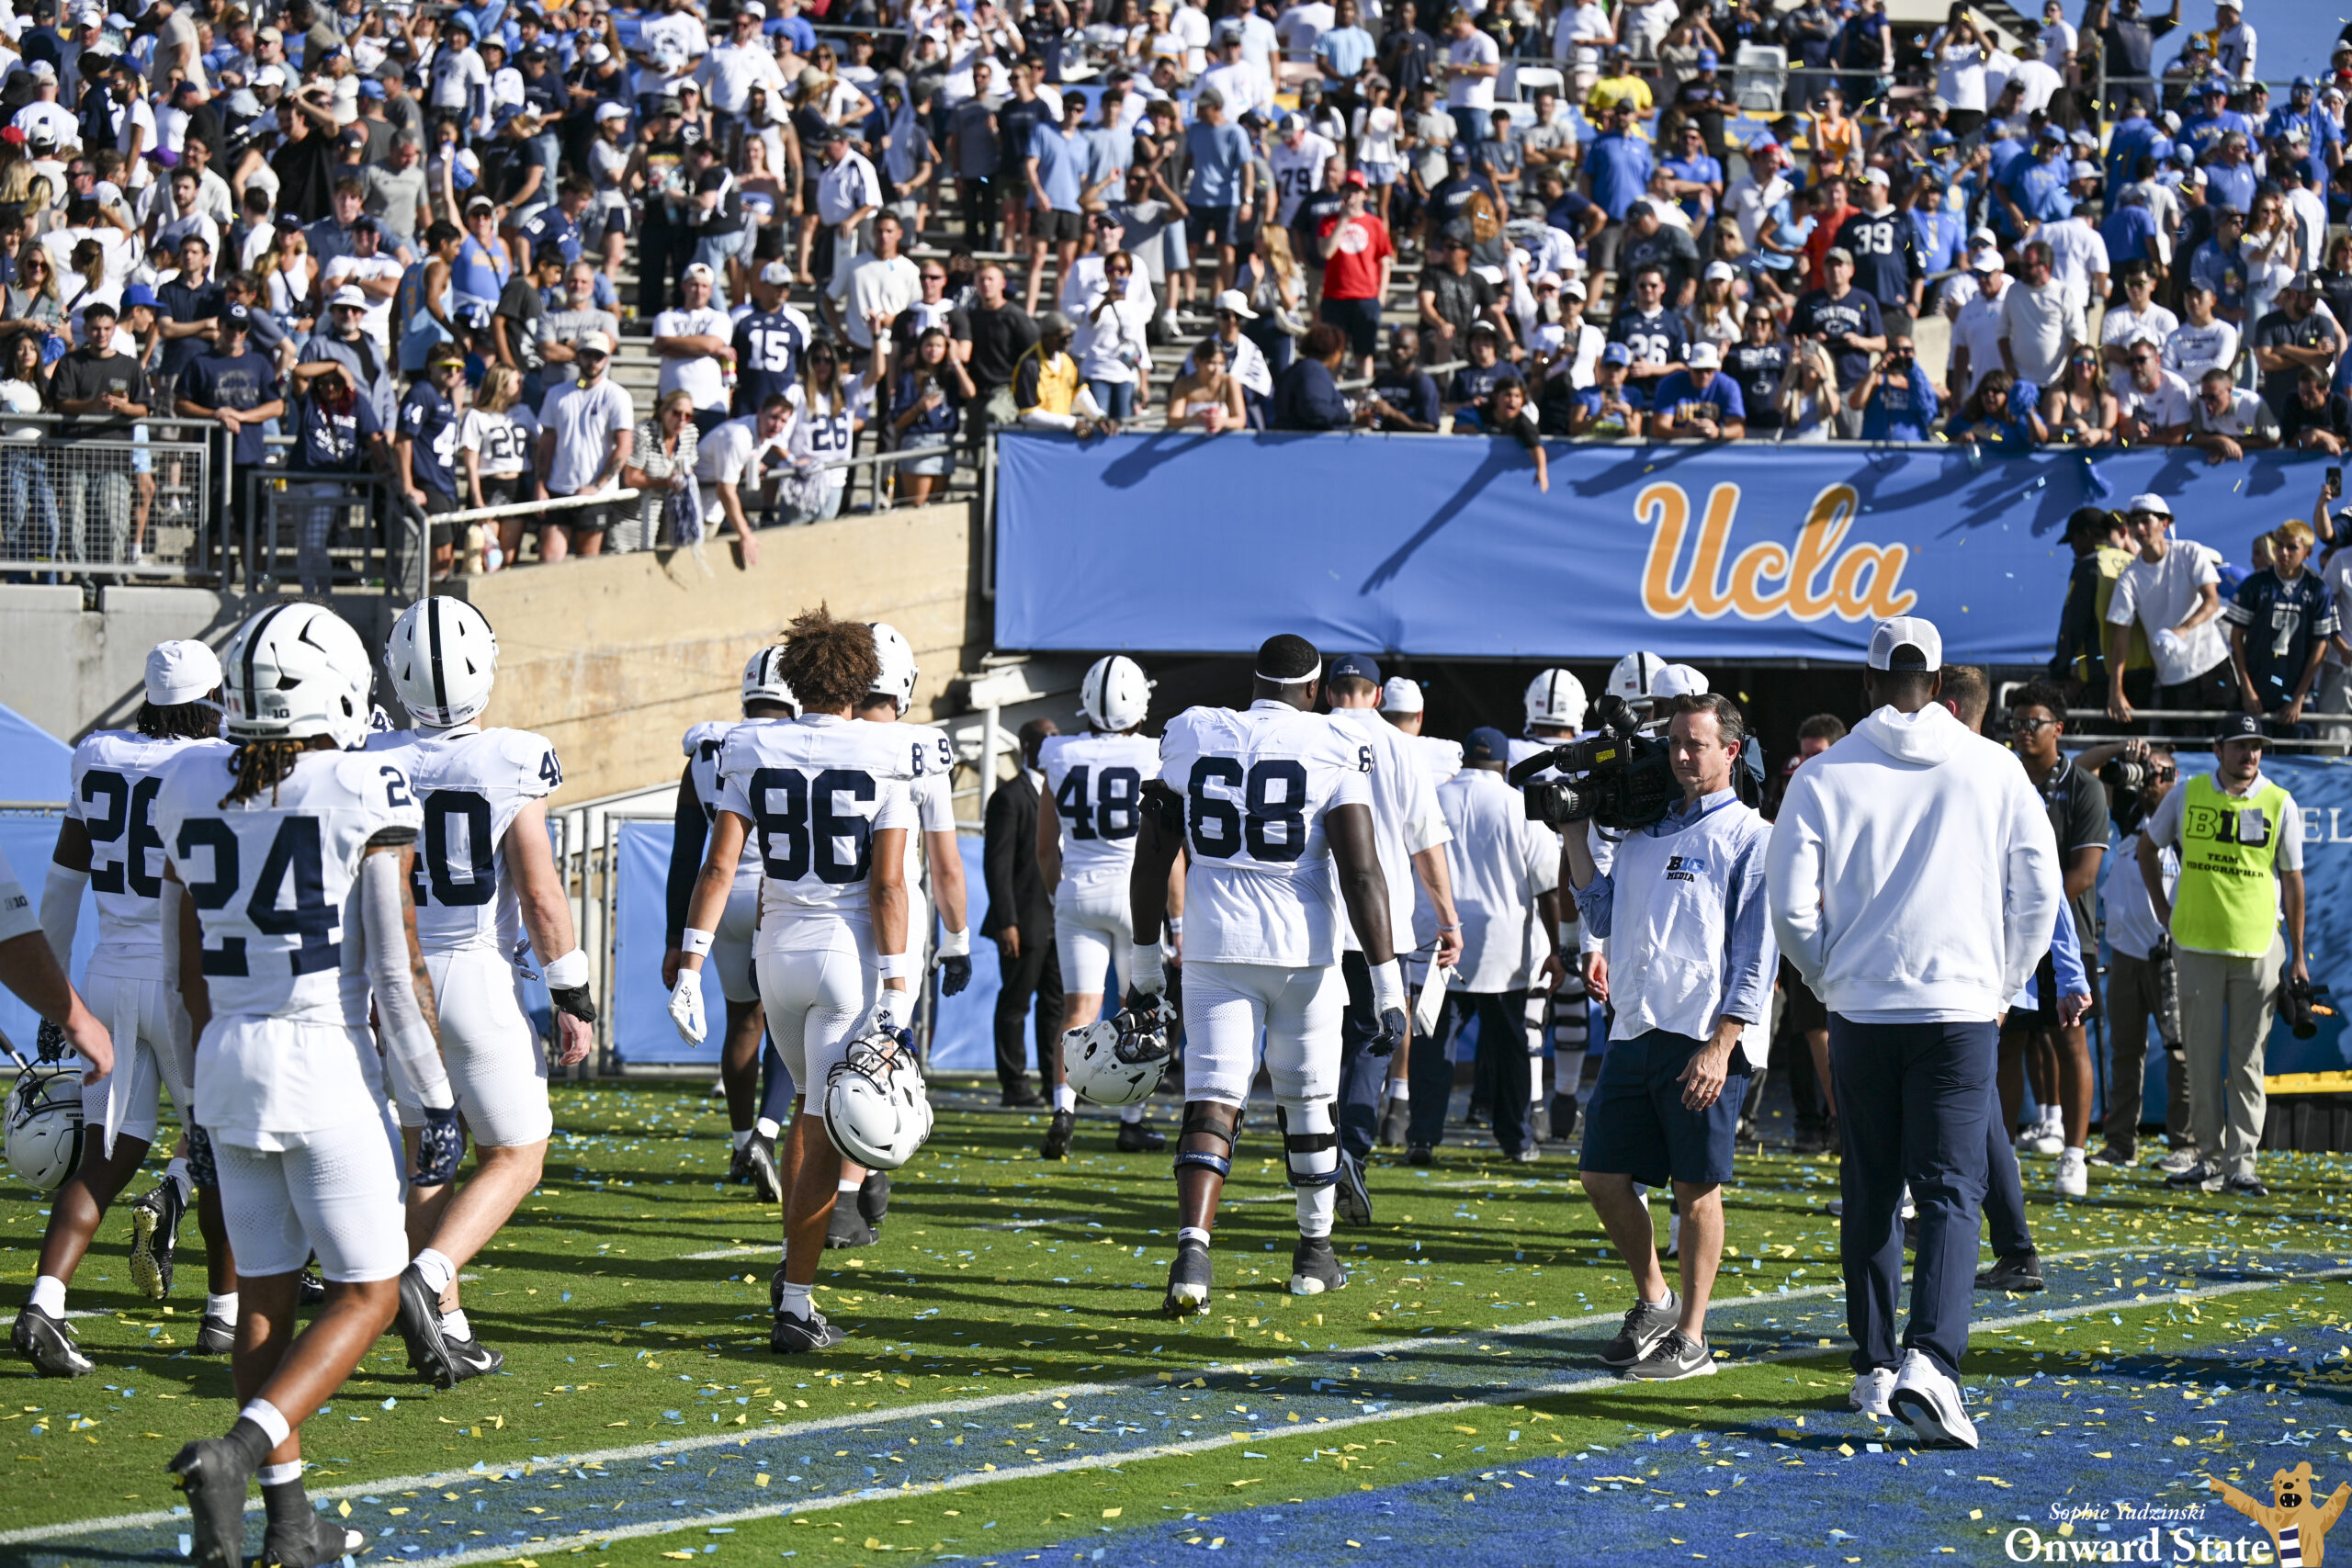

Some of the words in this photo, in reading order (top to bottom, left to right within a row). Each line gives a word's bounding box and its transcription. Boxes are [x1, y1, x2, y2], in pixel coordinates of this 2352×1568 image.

[1282, 168, 1310, 197] 79
[1853, 221, 1894, 255] 39
[748, 328, 791, 373] 15
[1627, 333, 1669, 367] 26
[432, 421, 458, 468] 4
[812, 412, 848, 451] 26
[2271, 611, 2301, 656] 7
[379, 766, 418, 808] 2
[1057, 765, 1141, 840] 48
[749, 767, 876, 885] 86
[1188, 756, 1307, 863] 68
[1666, 872, 1695, 883] MEDIA
[2186, 861, 2265, 878] VIDEOGRAPHER
[2207, 852, 2238, 864] TEAM
[175, 816, 340, 977] 24
